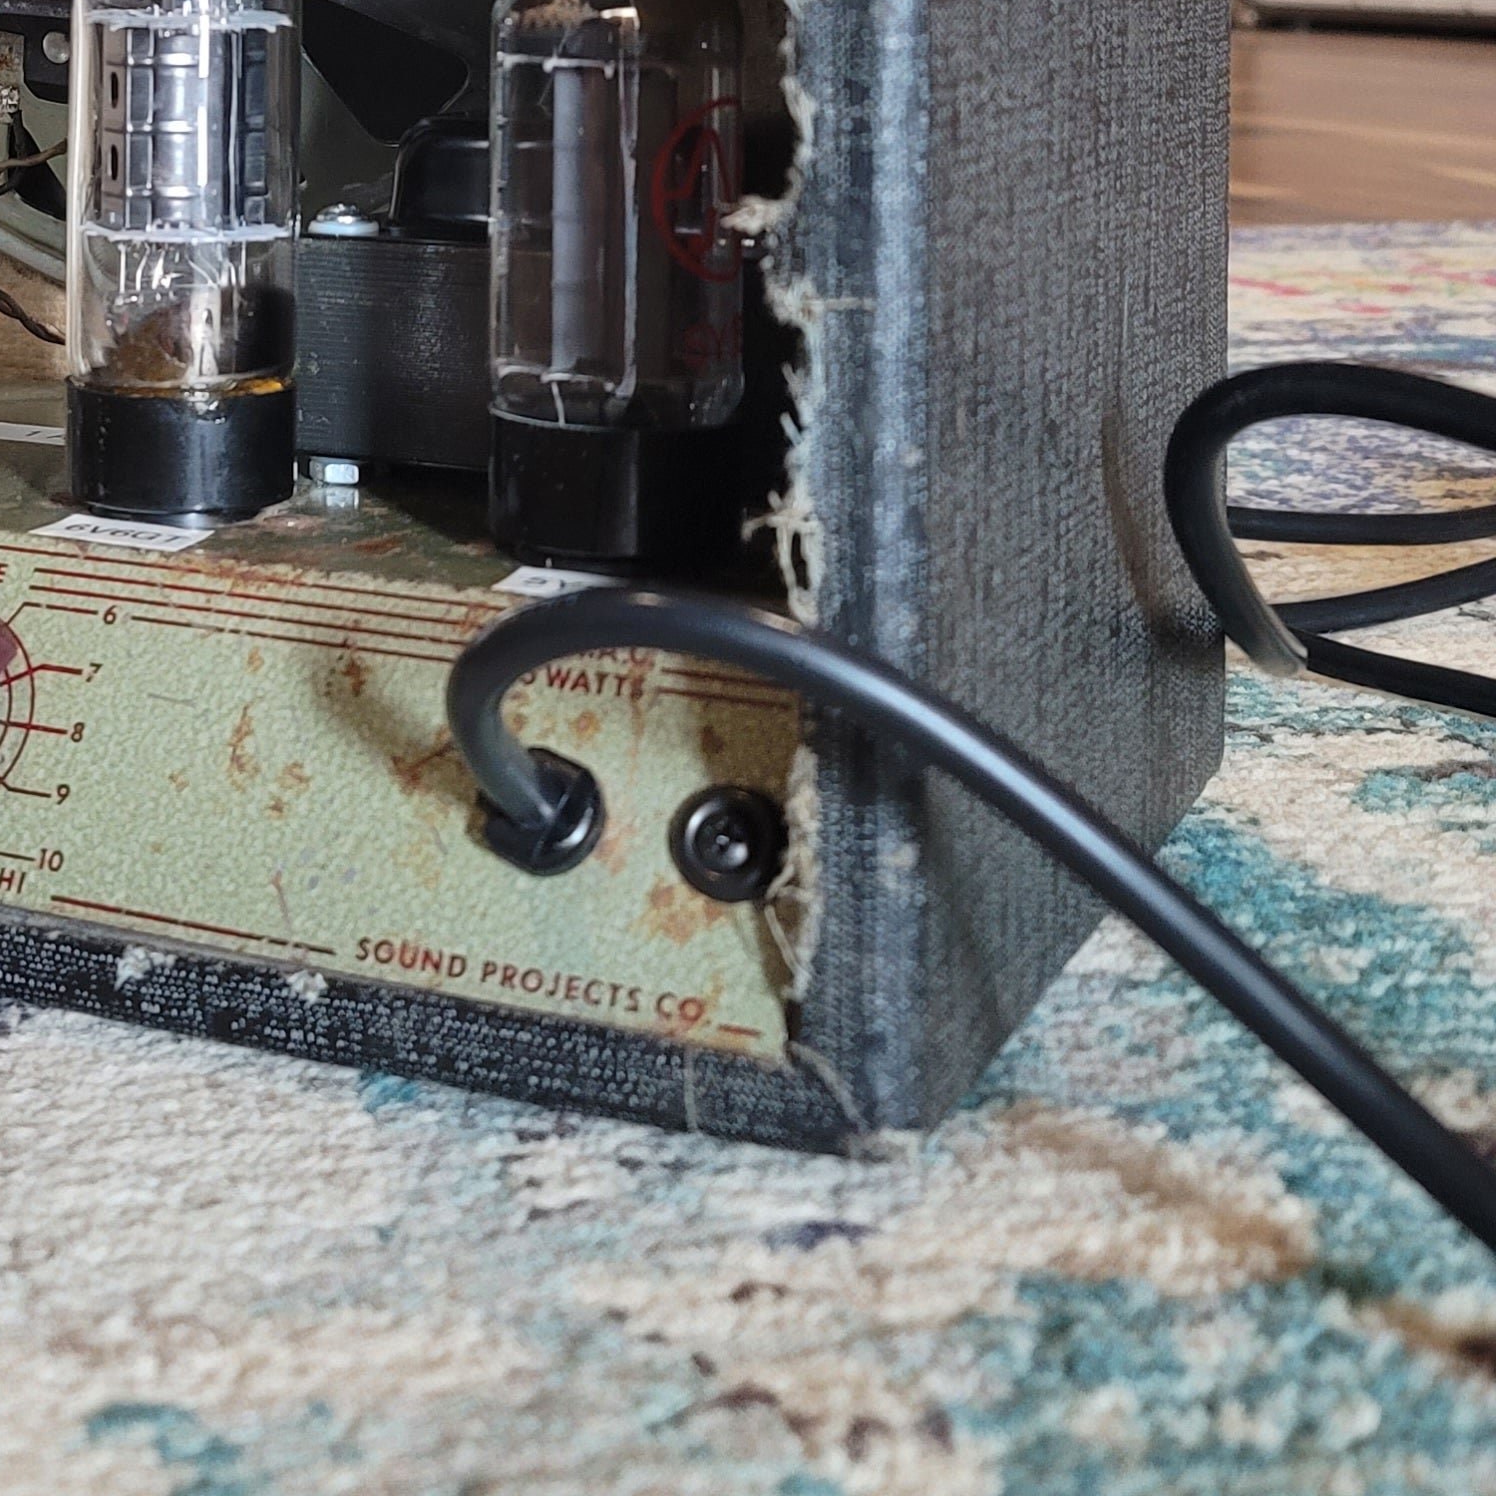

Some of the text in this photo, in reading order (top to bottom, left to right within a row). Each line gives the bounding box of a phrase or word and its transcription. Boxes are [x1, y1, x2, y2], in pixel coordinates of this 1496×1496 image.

[105, 607, 116, 624] 6
[86, 663, 101, 681] 7
[71, 722, 83, 742] 8
[56, 784, 69, 803] 9
[38, 849, 63, 871] 10
[355, 938, 712, 1027] SOUND PROJECTS CO.
